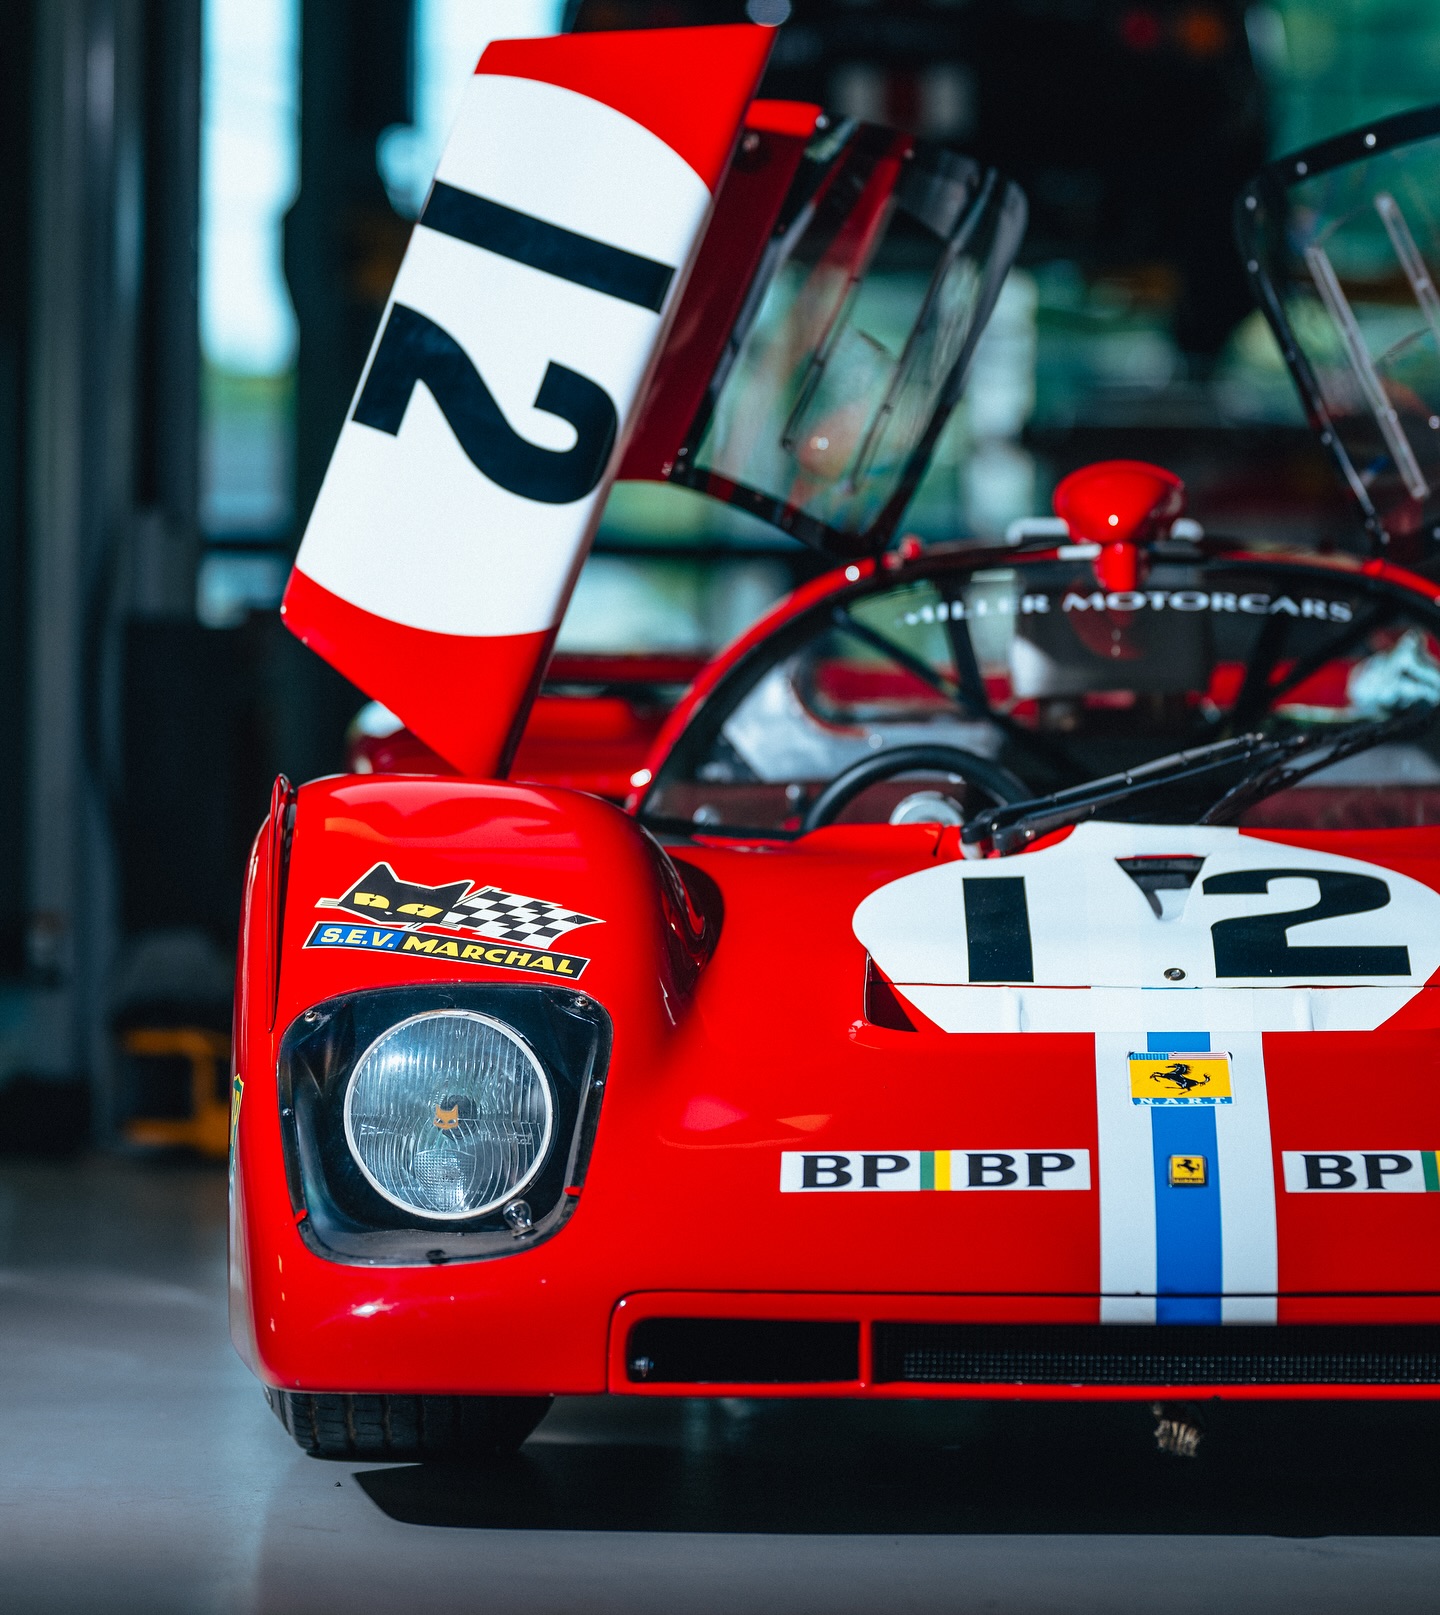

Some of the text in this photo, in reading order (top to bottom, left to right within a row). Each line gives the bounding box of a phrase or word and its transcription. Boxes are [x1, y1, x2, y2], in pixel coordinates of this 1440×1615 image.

[1062, 590, 1353, 623] MOTORCARS
[962, 868, 1412, 983] 12
[320, 927, 574, 974] S.E.V. MARCHAL
[801, 1154, 910, 1188] BP
[966, 1152, 1075, 1187] BP
[1304, 1153, 1413, 1189] BP
